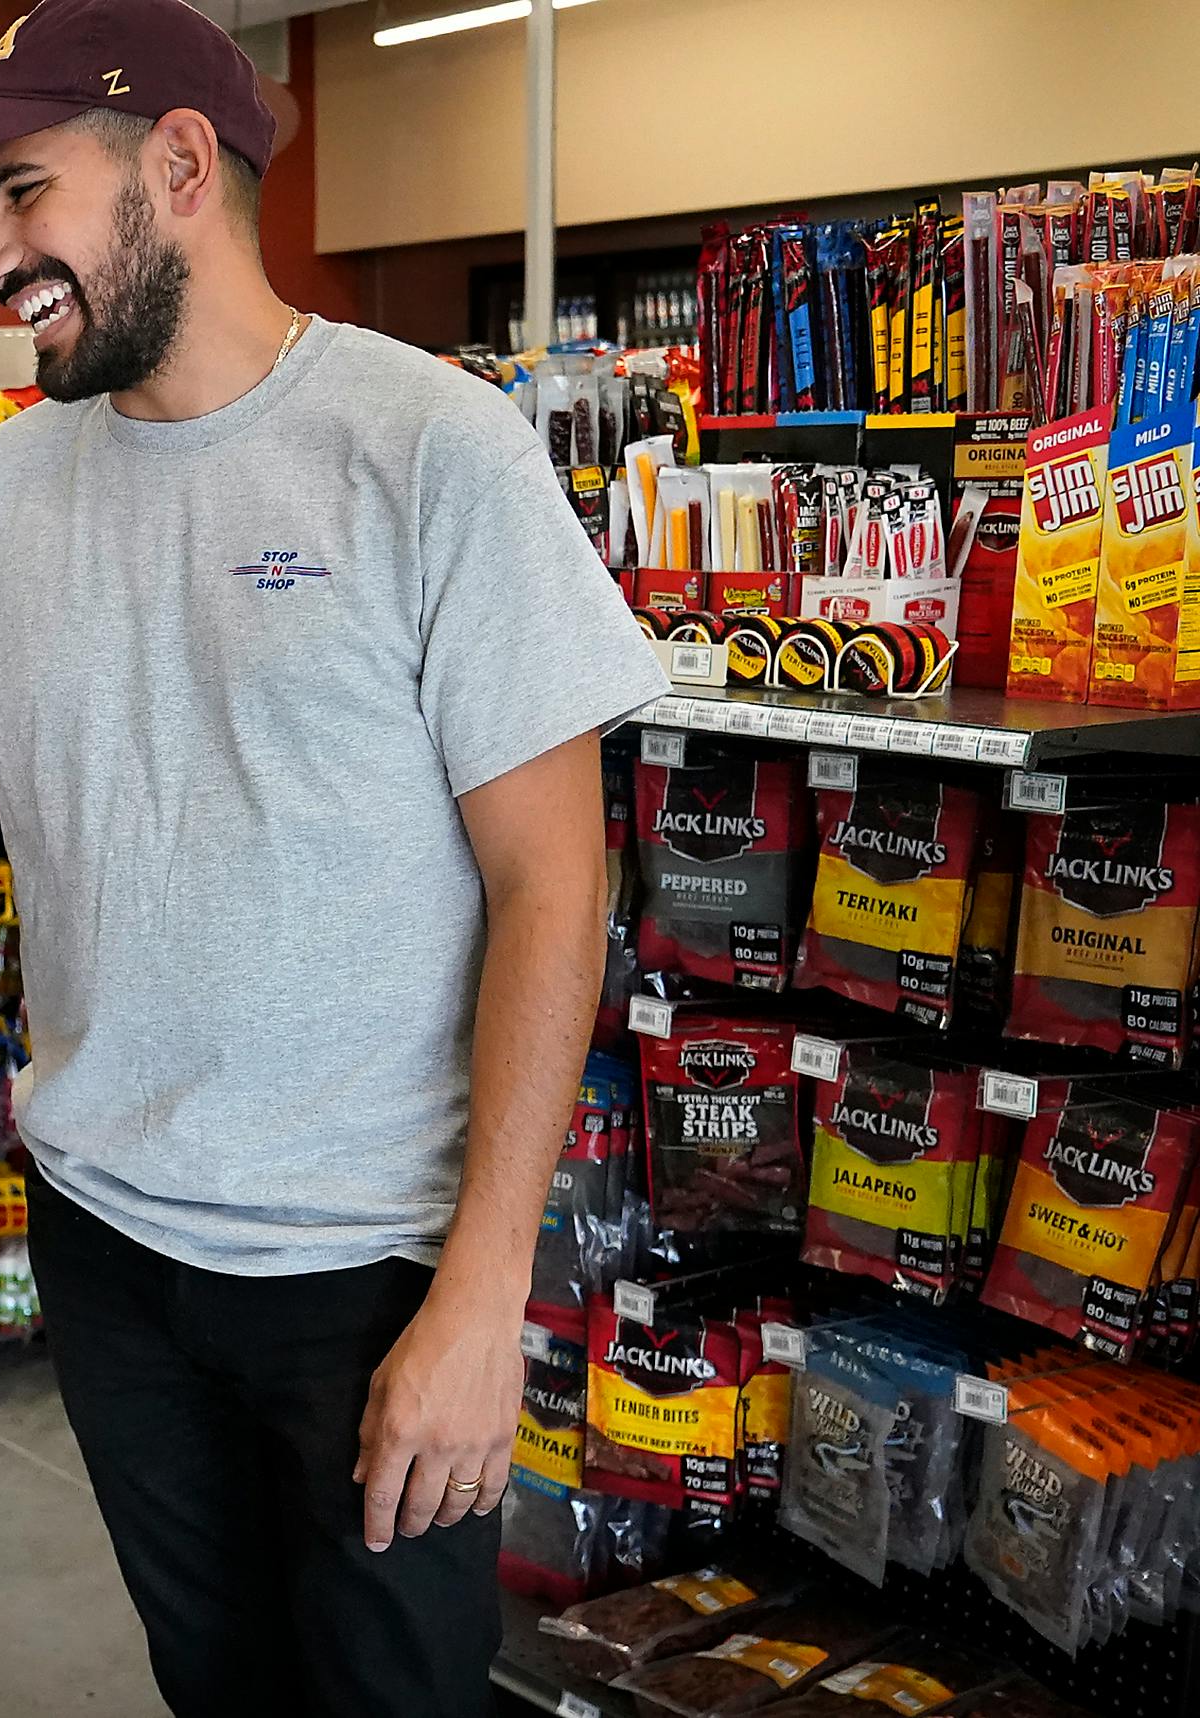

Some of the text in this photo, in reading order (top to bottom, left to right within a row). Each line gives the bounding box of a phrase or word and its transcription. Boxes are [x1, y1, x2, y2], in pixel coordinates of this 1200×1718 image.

[102, 69, 130, 96] Z
[916, 312, 928, 349] HOT
[1135, 358, 1146, 391] MILD
[1148, 361, 1161, 394] MILD
[1165, 368, 1177, 401] MILD
[988, 418, 1009, 431] 100%
[1009, 417, 1030, 431] BEEF
[1135, 423, 1172, 447] MILD
[1032, 419, 1103, 453] ORIGINAL
[967, 448, 1026, 461] ORIGINA
[1028, 460, 1095, 503] slim
[1112, 461, 1181, 504] slim
[1042, 484, 1100, 531] Jim
[1126, 485, 1186, 534] Jim
[977, 522, 1021, 535] ACK LINK
[261, 551, 298, 563] STOP
[271, 565, 283, 576] N
[1042, 565, 1092, 587] 6g PROTEIN
[1125, 569, 1176, 591] 6g PROTEIN
[256, 578, 296, 590] SHOP
[1045, 593, 1058, 604] NO
[1128, 597, 1141, 608] NO
[1097, 623, 1125, 633] SMOKED
[729, 649, 758, 671] TERIYAKI
[785, 652, 816, 679] TERIYAKI
[652, 809, 702, 836] JACK
[704, 812, 766, 840] LINK'S
[829, 821, 947, 864] JACK LINK'S
[1044, 853, 1173, 892] JACK LINK'S
[660, 872, 748, 896] PEPPERED
[837, 890, 918, 923] TERIYAKI
[733, 925, 756, 940] 10g
[1051, 926, 1147, 955] ORIGINAL
[735, 946, 752, 960] 80
[902, 953, 925, 971] 10g
[900, 975, 919, 990] 80
[1130, 990, 1178, 1008] 11g PROTEIN
[1127, 1013, 1177, 1034] 80 CALORIES
[677, 1051, 712, 1069] JACK
[676, 1094, 761, 1105] EXTRA THICK CUT
[684, 1103, 754, 1121] STEAK
[682, 1119, 759, 1139] STRIPS
[829, 1102, 938, 1147] JACK LINK'S
[1042, 1137, 1155, 1193] JACK LINK'S
[832, 1168, 917, 1202] JALAPEÑO
[1028, 1202, 1129, 1252] SWEET & HOT
[902, 1232, 920, 1246] 11g
[900, 1253, 917, 1267] 80
[1091, 1280, 1114, 1301] 10g
[1086, 1303, 1104, 1320] 80
[604, 1341, 653, 1372] JACK
[613, 1398, 700, 1425] TENDER BITES
[607, 1428, 649, 1447] TERIYAKI
[674, 1440, 707, 1456] STEAK
[686, 1457, 706, 1473] 10g
[685, 1475, 702, 1490] 70
